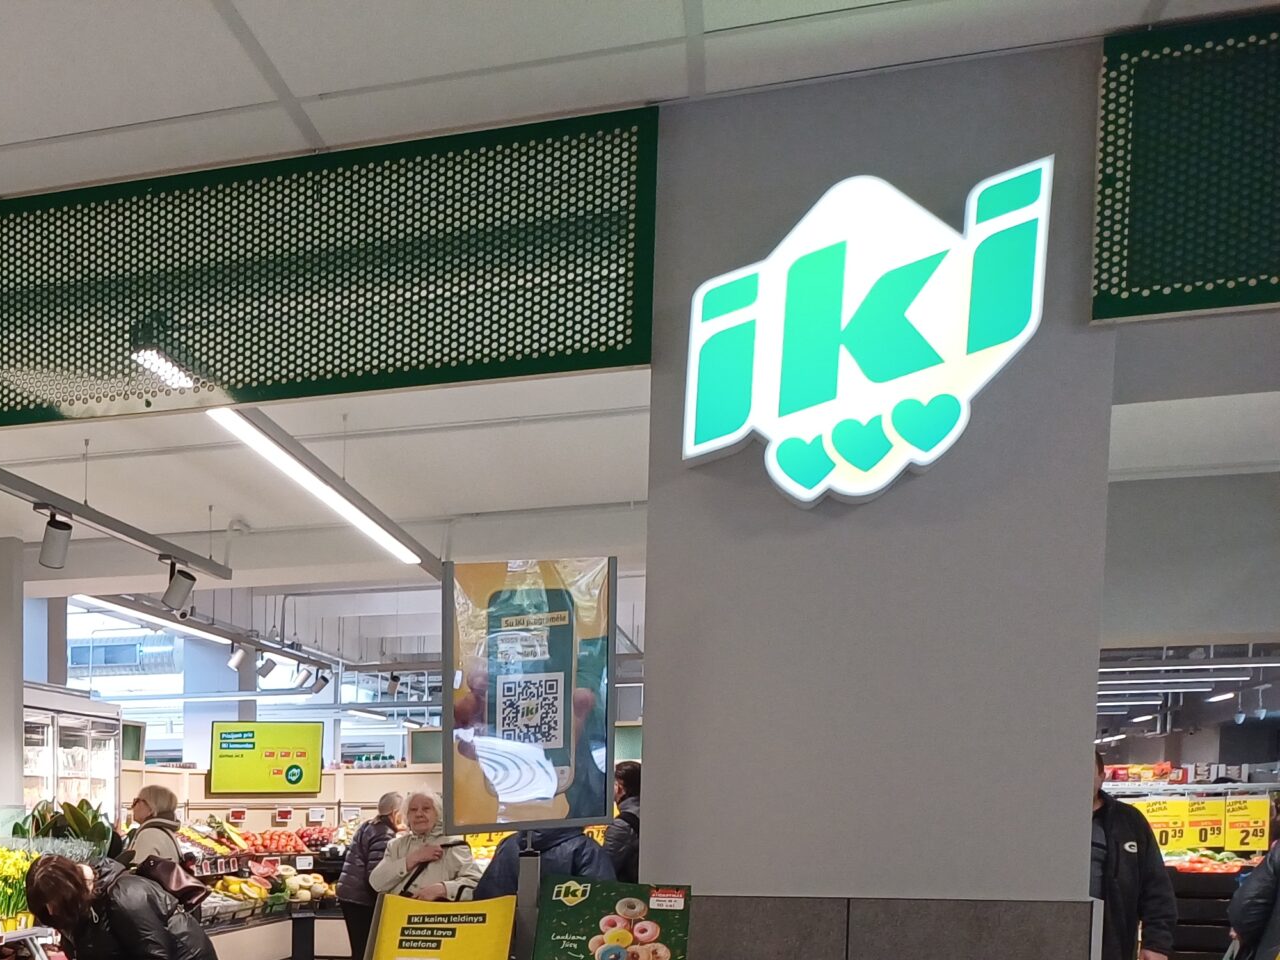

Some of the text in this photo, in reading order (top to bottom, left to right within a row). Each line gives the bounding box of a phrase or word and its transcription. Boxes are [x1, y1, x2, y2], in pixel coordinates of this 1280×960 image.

[693, 168, 1042, 447] iki
[1240, 828, 1265, 845] 2 49
[554, 883, 589, 899] iki
[450, 915, 483, 924] leidinys
[404, 928, 431, 936] visada
[402, 941, 437, 949] telefone
